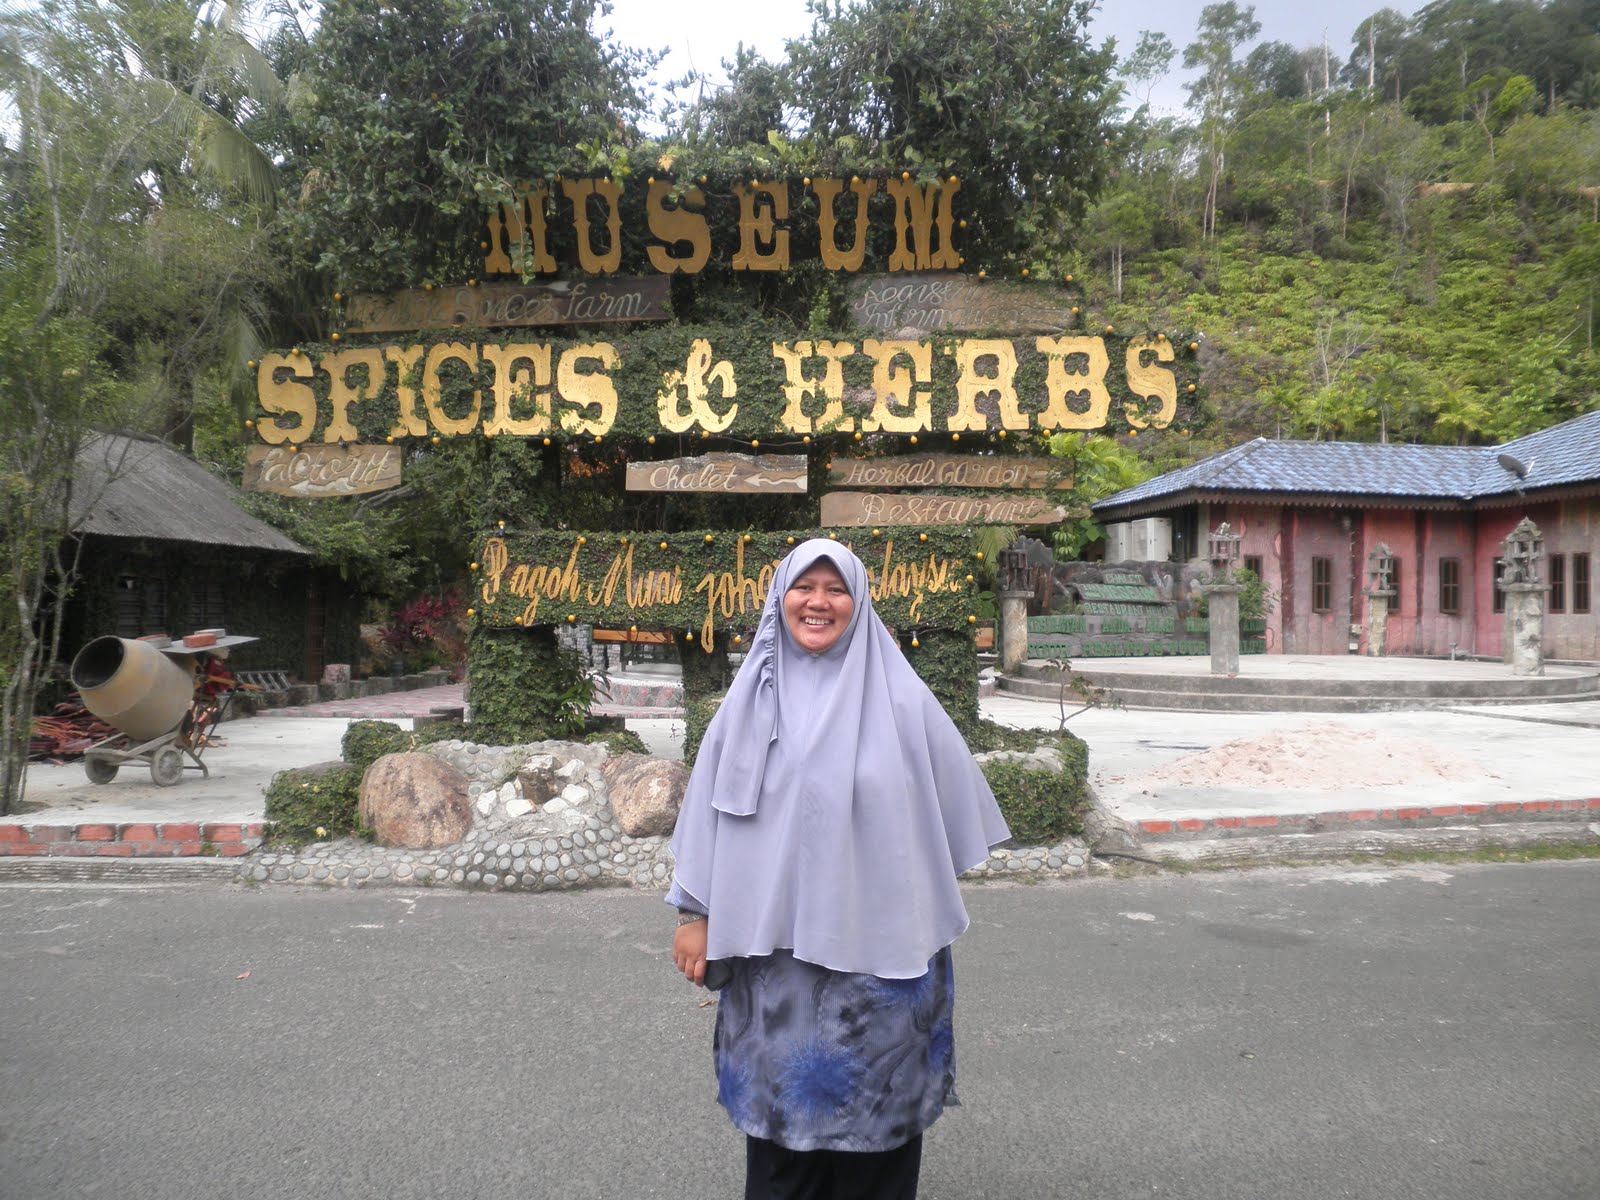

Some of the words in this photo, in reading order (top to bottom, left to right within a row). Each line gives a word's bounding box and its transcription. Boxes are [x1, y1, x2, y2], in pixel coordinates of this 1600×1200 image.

[485, 178, 961, 274] MUSEUM
[257, 341, 621, 443] SPICES
[657, 338, 738, 433] &
[772, 336, 1177, 434] HERBS
[650, 463, 738, 491] Chalet
[842, 458, 936, 486] Herbal
[857, 493, 1044, 525] Restaurant
[482, 536, 581, 627] Pagoh
[588, 543, 683, 609] Muar
